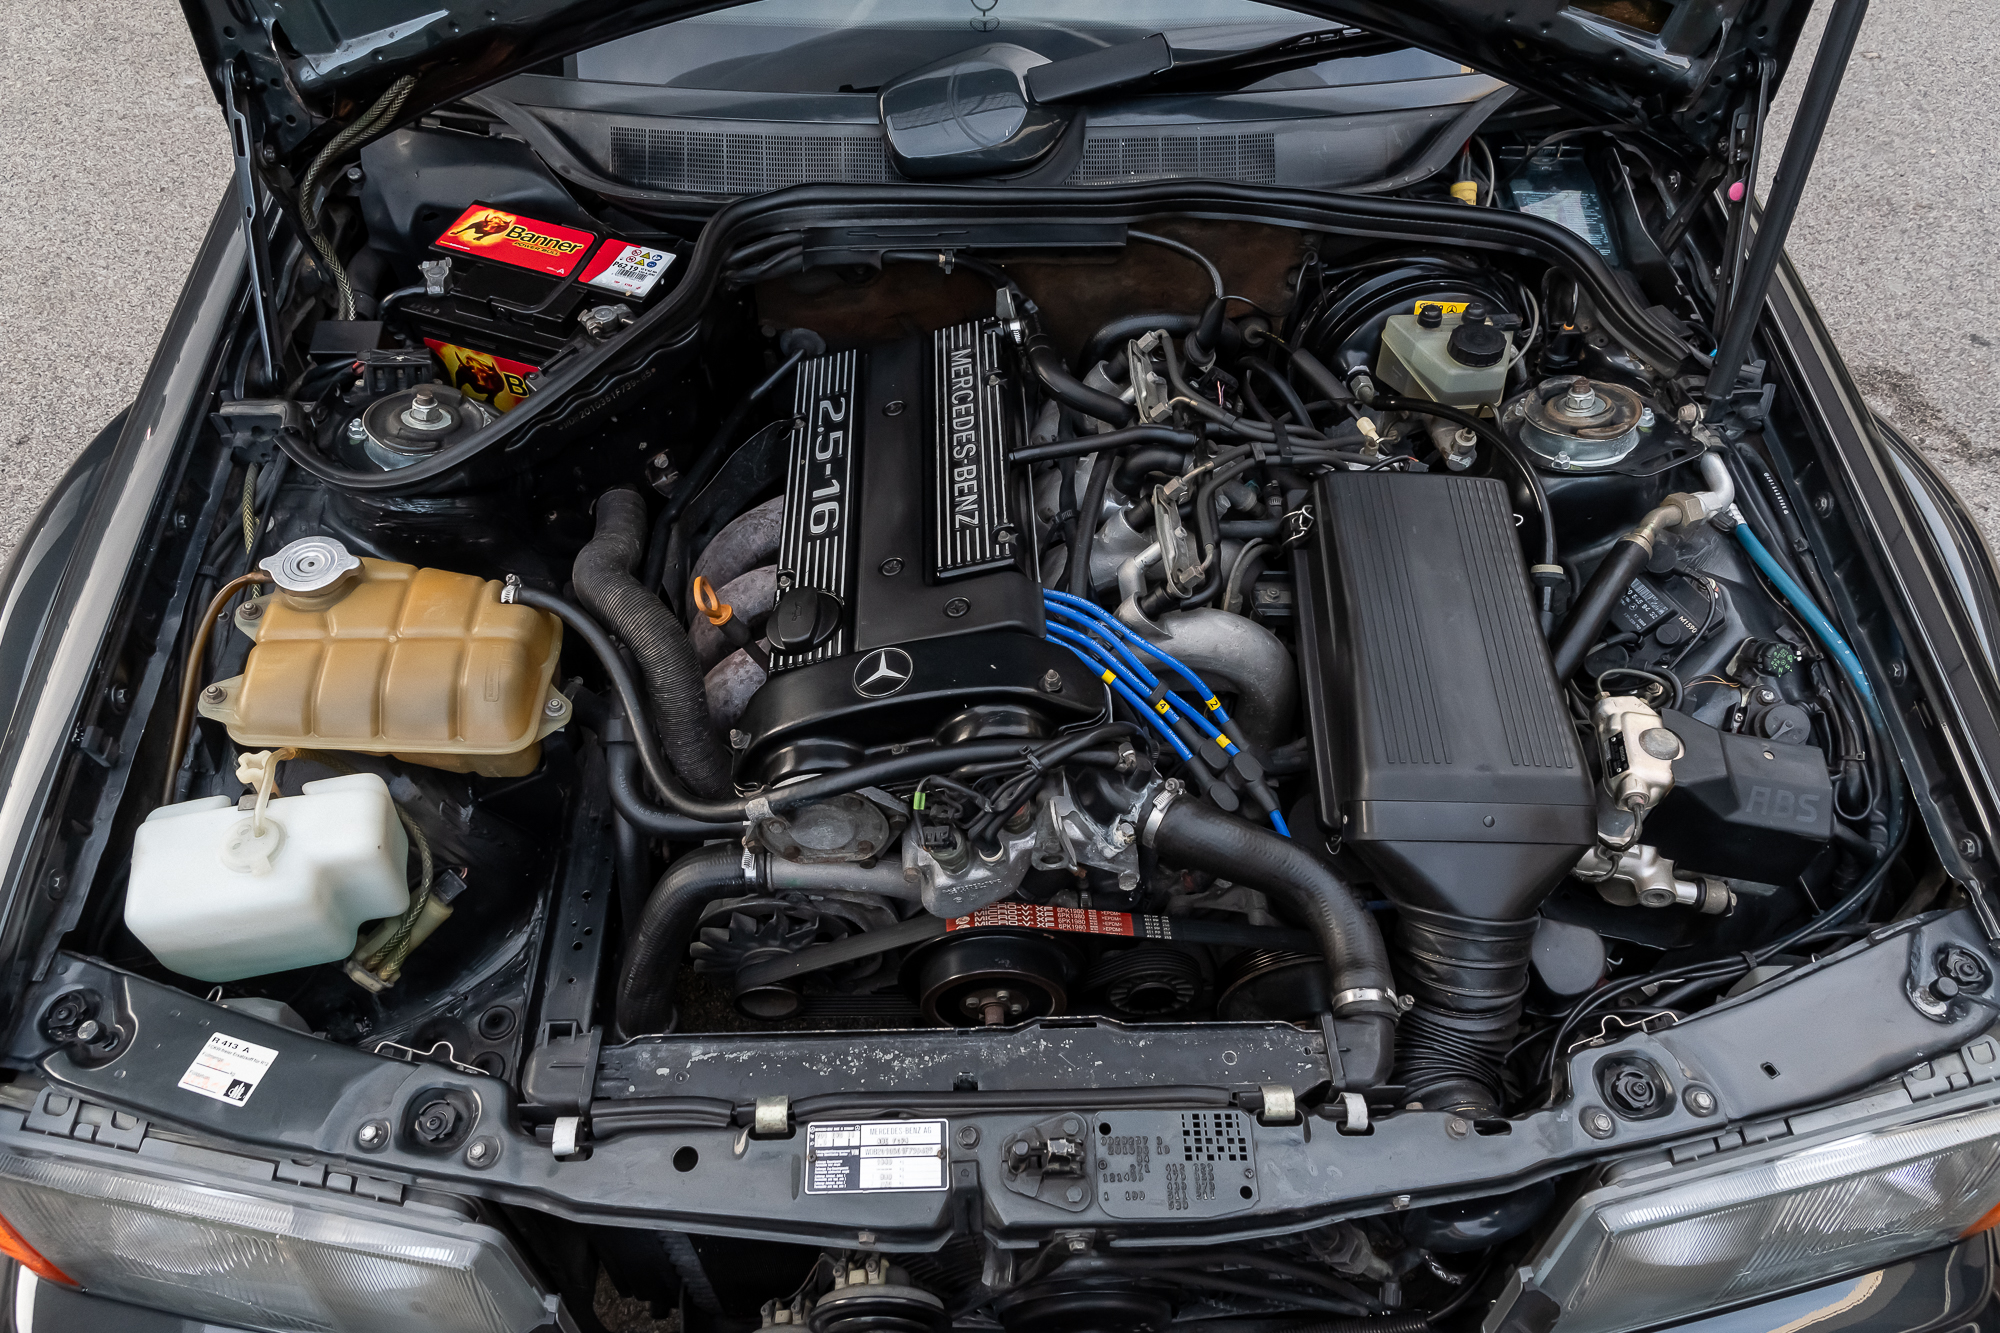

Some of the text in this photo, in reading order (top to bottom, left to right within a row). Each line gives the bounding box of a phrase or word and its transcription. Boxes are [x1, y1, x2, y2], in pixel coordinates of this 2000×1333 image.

[505, 225, 584, 254] Banner
[951, 348, 980, 530] MERCEDES-BENZ
[809, 397, 846, 535] 2.5-16
[1679, 616, 1698, 634] M1590
[1159, 701, 1167, 710] 4
[1210, 700, 1218, 708] 2
[1745, 786, 1820, 823] ABS
[222, 1040, 238, 1050] 413
[870, 1126, 921, 1136] MERCEDES-BENZ
